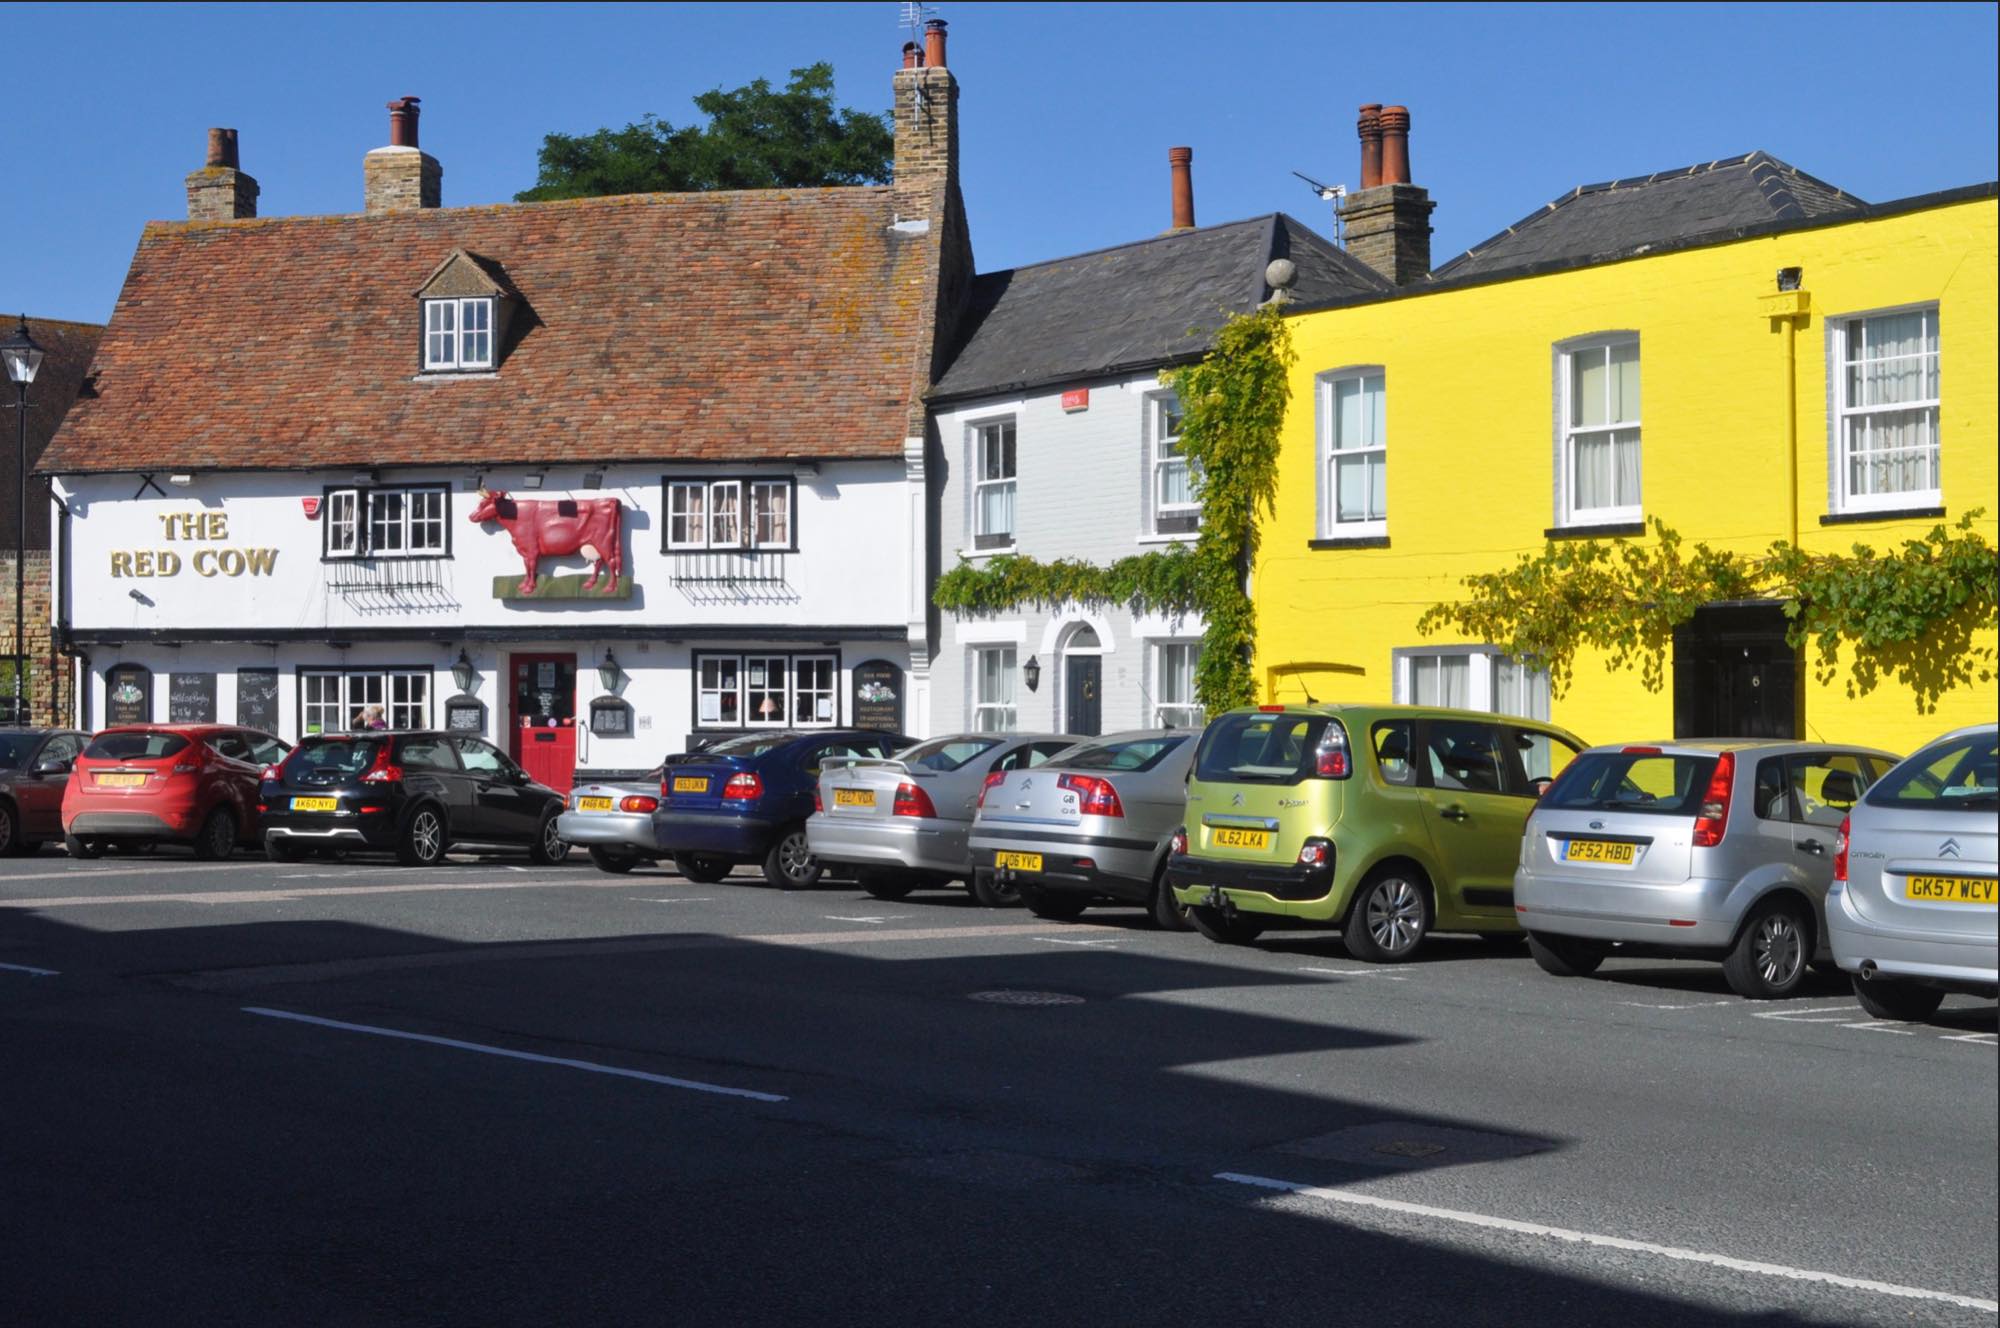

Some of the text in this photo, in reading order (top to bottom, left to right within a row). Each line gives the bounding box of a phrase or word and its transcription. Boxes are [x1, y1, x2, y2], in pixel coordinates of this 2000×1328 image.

[159, 512, 229, 541] THE
[110, 548, 279, 578] RED COW
[1752, 675, 1760, 687] 6
[296, 799, 317, 808] AK60
[1216, 831, 1262, 847] NL62 LKA
[1569, 843, 1632, 861] GF52 HBD
[1021, 855, 1039, 869] YVC
[1912, 878, 1993, 899] GK57 WCV
